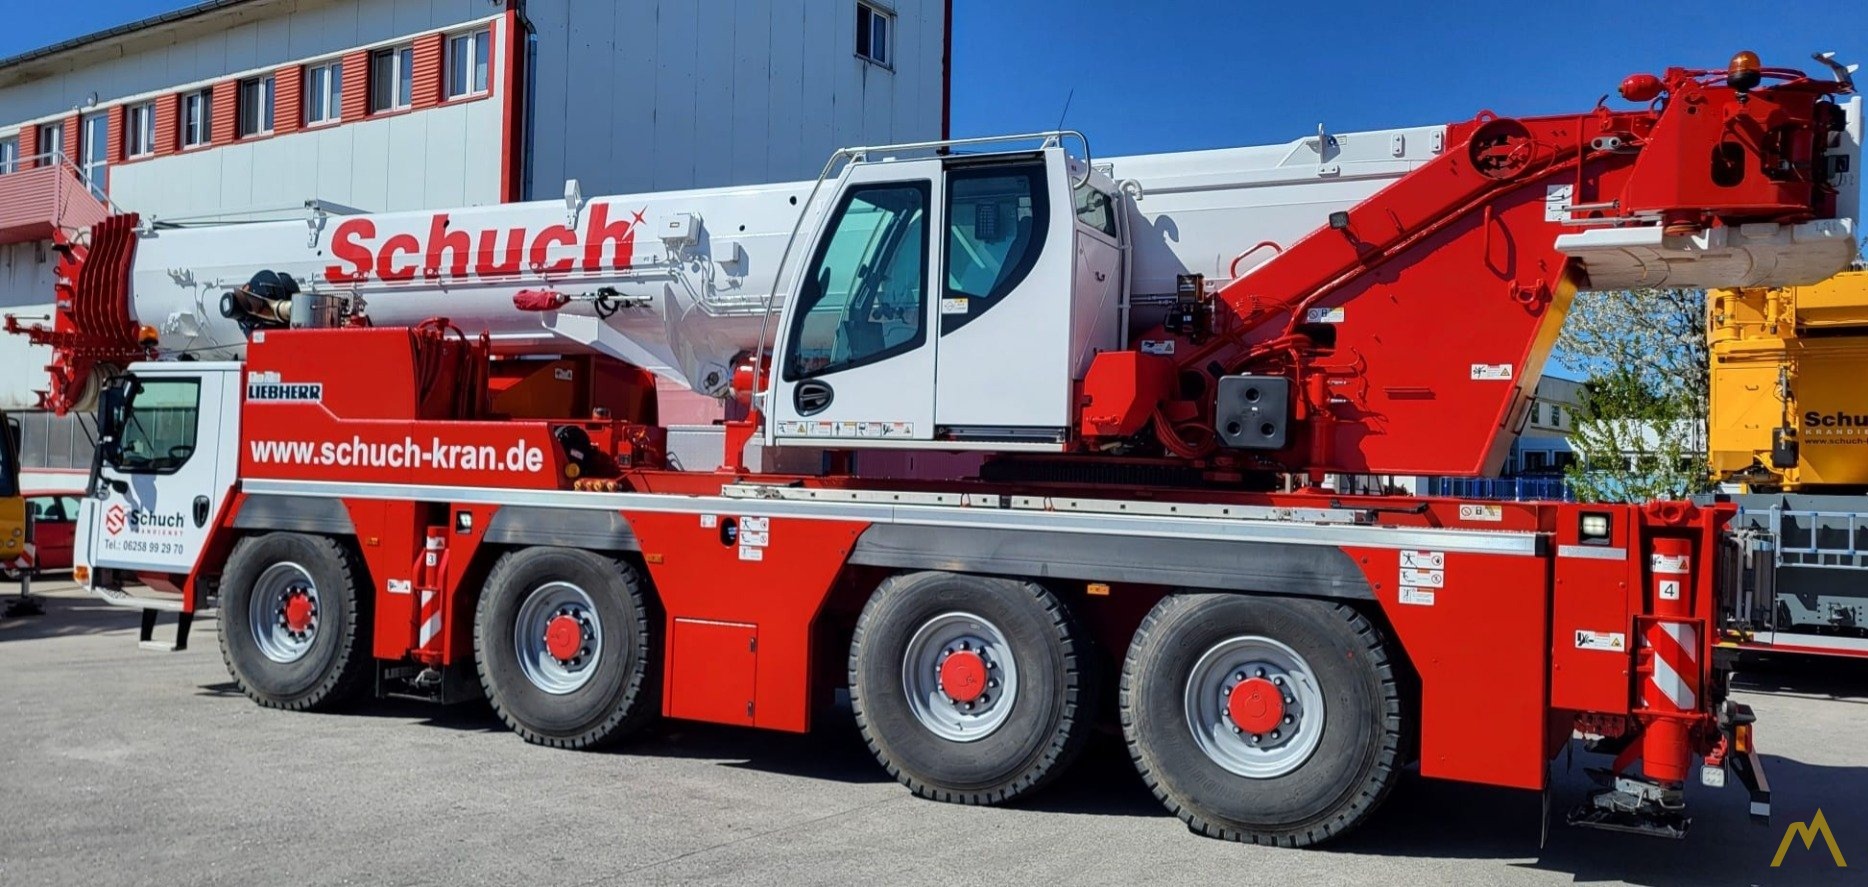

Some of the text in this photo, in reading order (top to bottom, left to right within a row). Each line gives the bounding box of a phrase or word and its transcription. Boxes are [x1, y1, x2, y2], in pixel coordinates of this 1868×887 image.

[324, 202, 636, 284] Schuch
[248, 385, 320, 399] LIEBHERR
[1804, 411, 1868, 427] Schu
[250, 436, 544, 472] www.schuch-kran.de
[130, 509, 184, 528] Schuch
[105, 539, 184, 555] Tel.: 06258 99 29 70
[1664, 583, 1675, 597] 4
